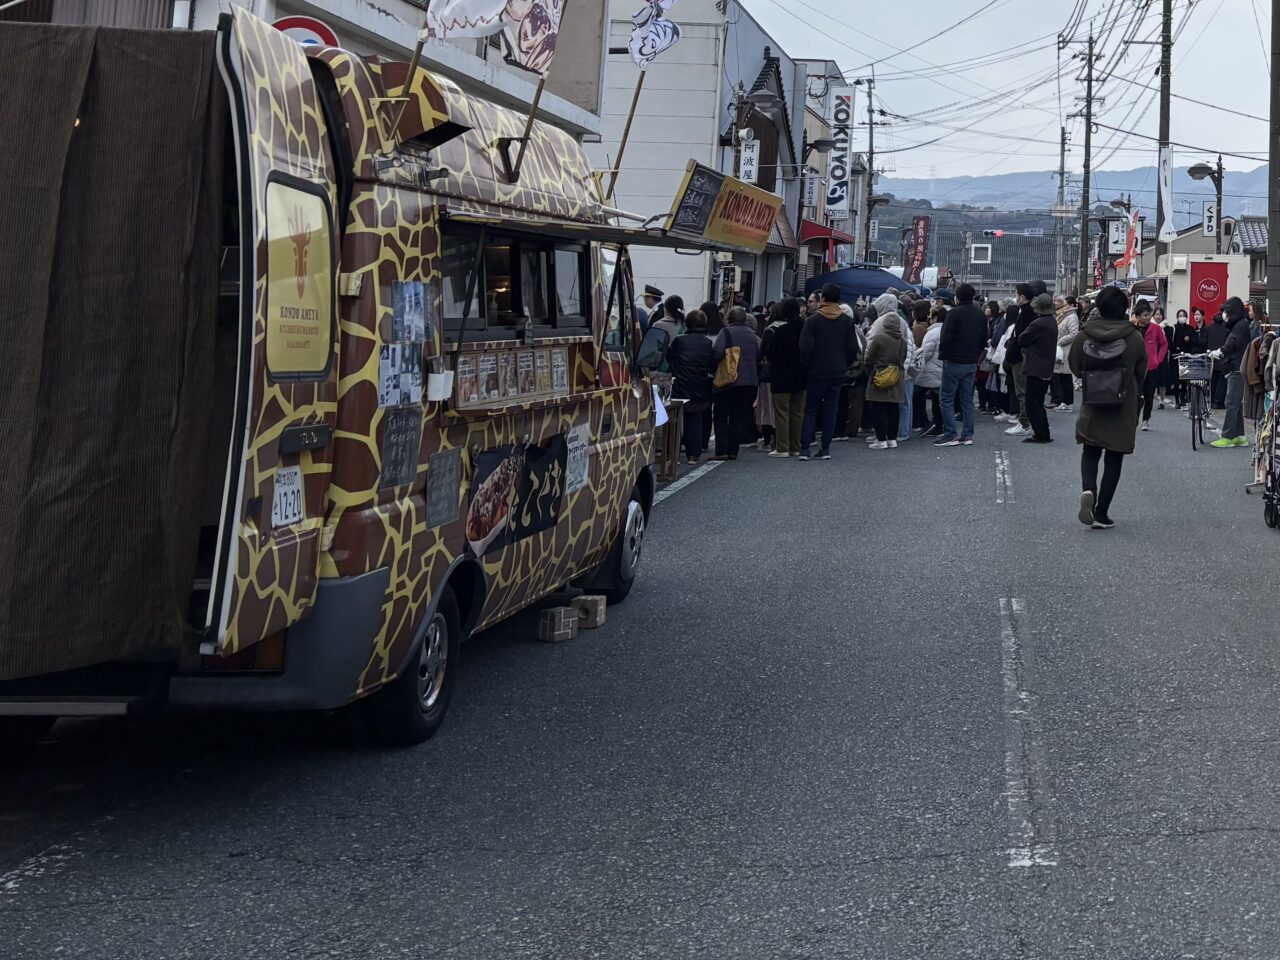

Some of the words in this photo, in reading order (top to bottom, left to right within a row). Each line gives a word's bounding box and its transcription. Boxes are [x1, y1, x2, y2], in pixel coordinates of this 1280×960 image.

[831, 95, 852, 181] KOKUYO
[743, 143, 756, 180] 阿波屋
[719, 190, 754, 225] KONDO
[1206, 206, 1214, 233] くすり
[280, 306, 300, 320] KONDO
[301, 308, 319, 321] AMEYA
